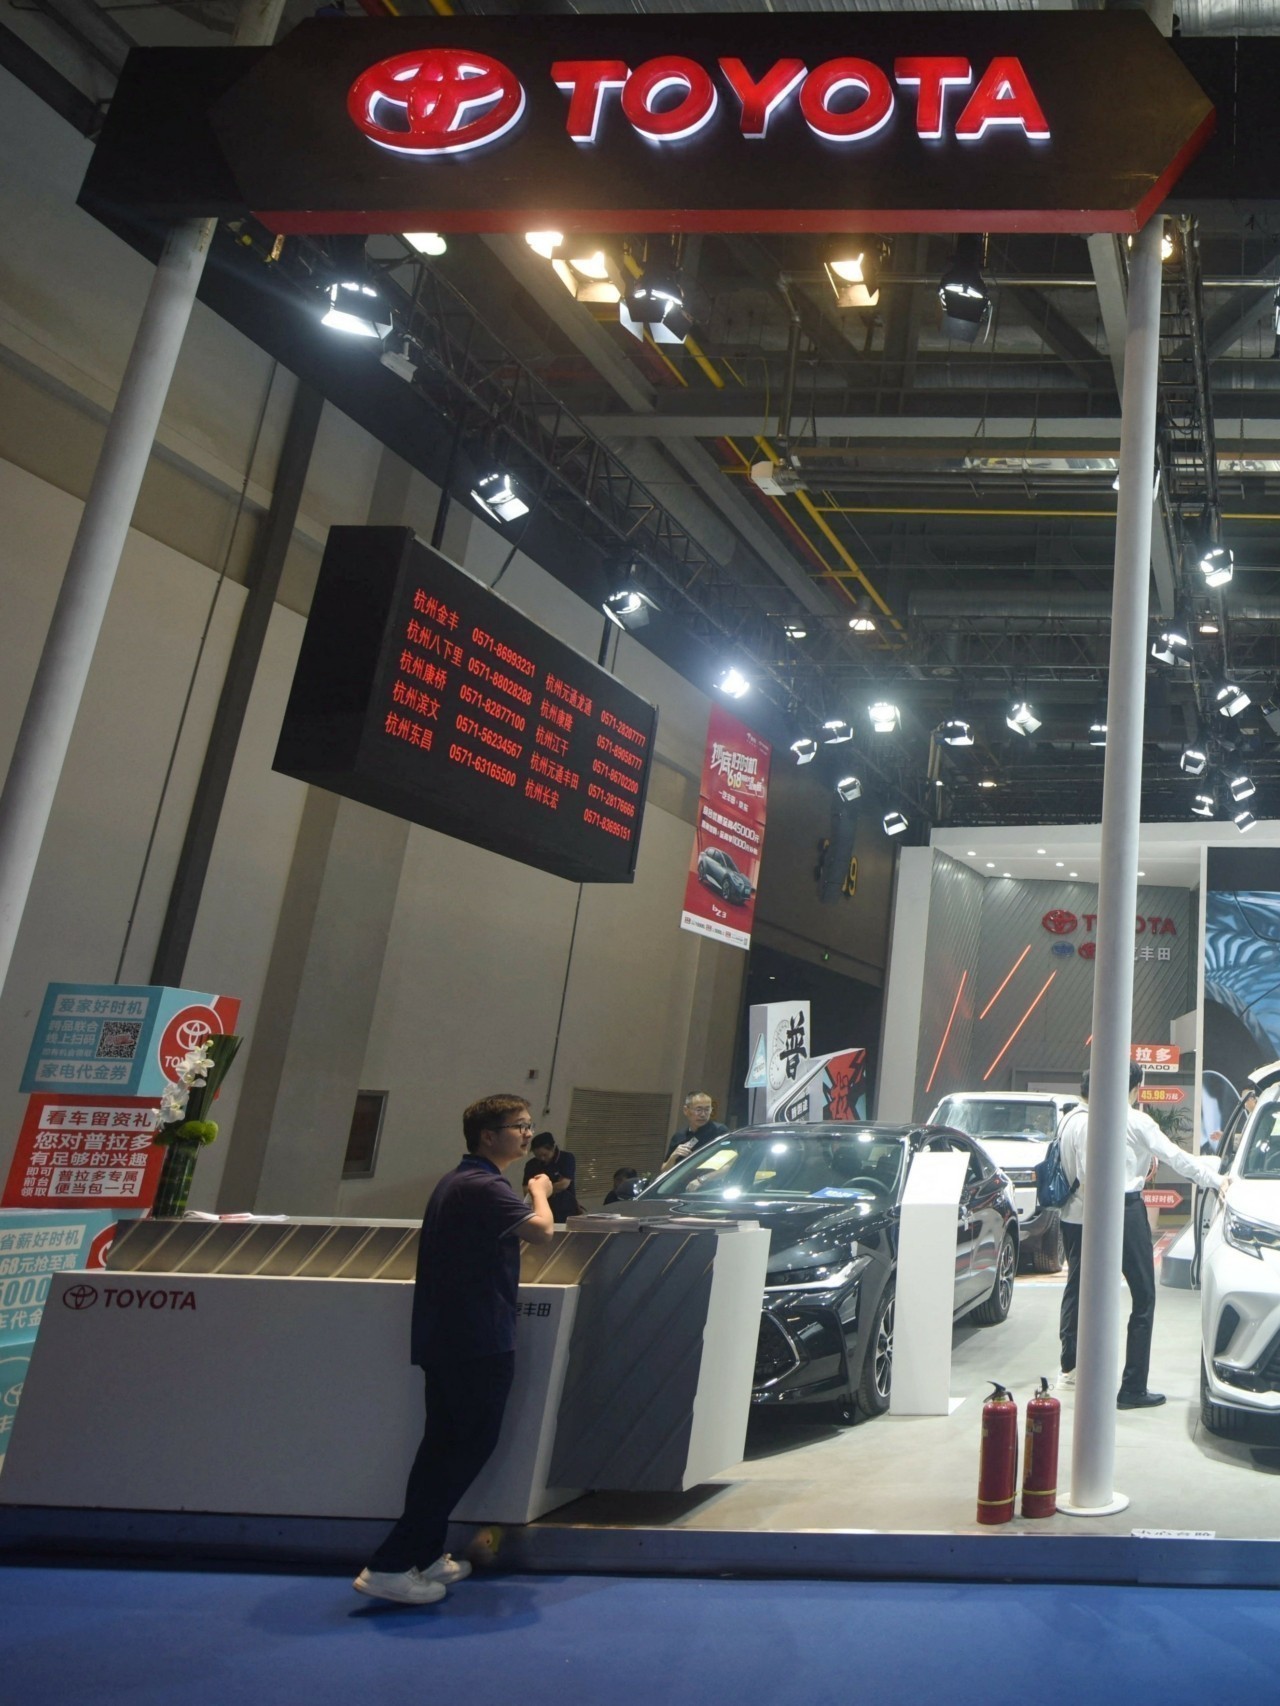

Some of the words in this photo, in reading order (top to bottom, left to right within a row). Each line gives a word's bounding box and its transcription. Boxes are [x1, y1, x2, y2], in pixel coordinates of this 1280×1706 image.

[550, 54, 1051, 143] TOYOTA
[413, 588, 460, 632] 杭州金丰
[471, 626, 536, 678] 0571-86993231
[406, 618, 464, 668] 杭州八下里
[468, 656, 533, 706] 0571-88028288
[399, 649, 448, 692] 杭州康桥
[459, 684, 526, 732] 0571-82877100
[392, 679, 441, 721] 杭州滨文
[455, 714, 523, 759] 0571-56234567
[384, 711, 434, 752] 杭州东昌
[449, 743, 517, 788] 0571-63165500
[58, 997, 144, 1015] 爱家好时机
[1131, 1047, 1172, 1062] 拉多
[40, 1063, 127, 1081] 家电代金券
[46, 1106, 152, 1127] 看车留资礼
[33, 1131, 153, 1150] 您对普拉多
[29, 1151, 149, 1167] 有足够的兴趣
[26, 1166, 52, 1177] 即可
[58, 1169, 139, 1182] 普拉多专属
[21, 1186, 48, 1197] 领取
[23, 1177, 49, 1187] 前台
[54, 1182, 136, 1195] 便当包一只
[0, 1229, 80, 1251] 省薪好时机
[0, 1276, 52, 1307] 000
[103, 1288, 197, 1311] TOYOTA
